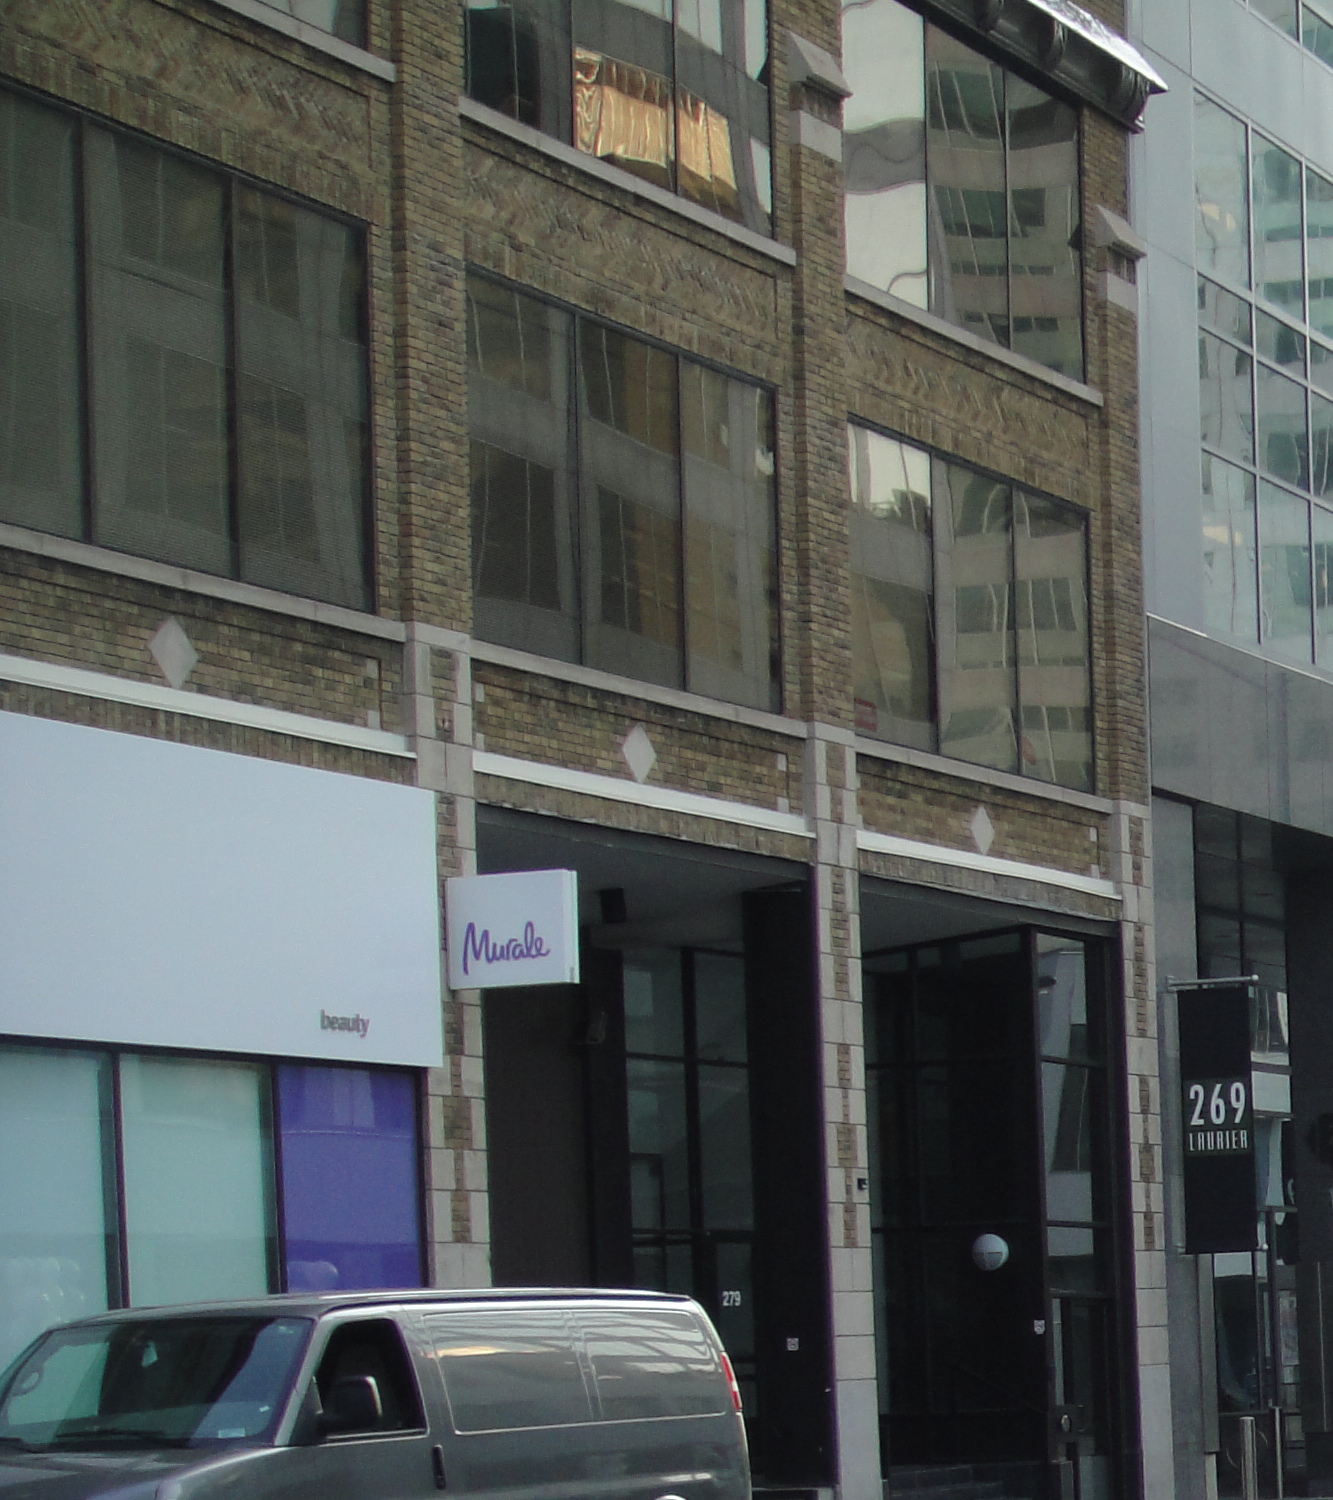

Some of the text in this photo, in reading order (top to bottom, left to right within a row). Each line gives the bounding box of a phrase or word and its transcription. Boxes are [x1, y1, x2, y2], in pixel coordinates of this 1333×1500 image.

[463, 921, 551, 975] Murale
[320, 1009, 371, 1038] beauty
[1189, 1081, 1246, 1126] 269
[1188, 1129, 1248, 1151] LAURIER
[722, 1290, 741, 1306] 279
